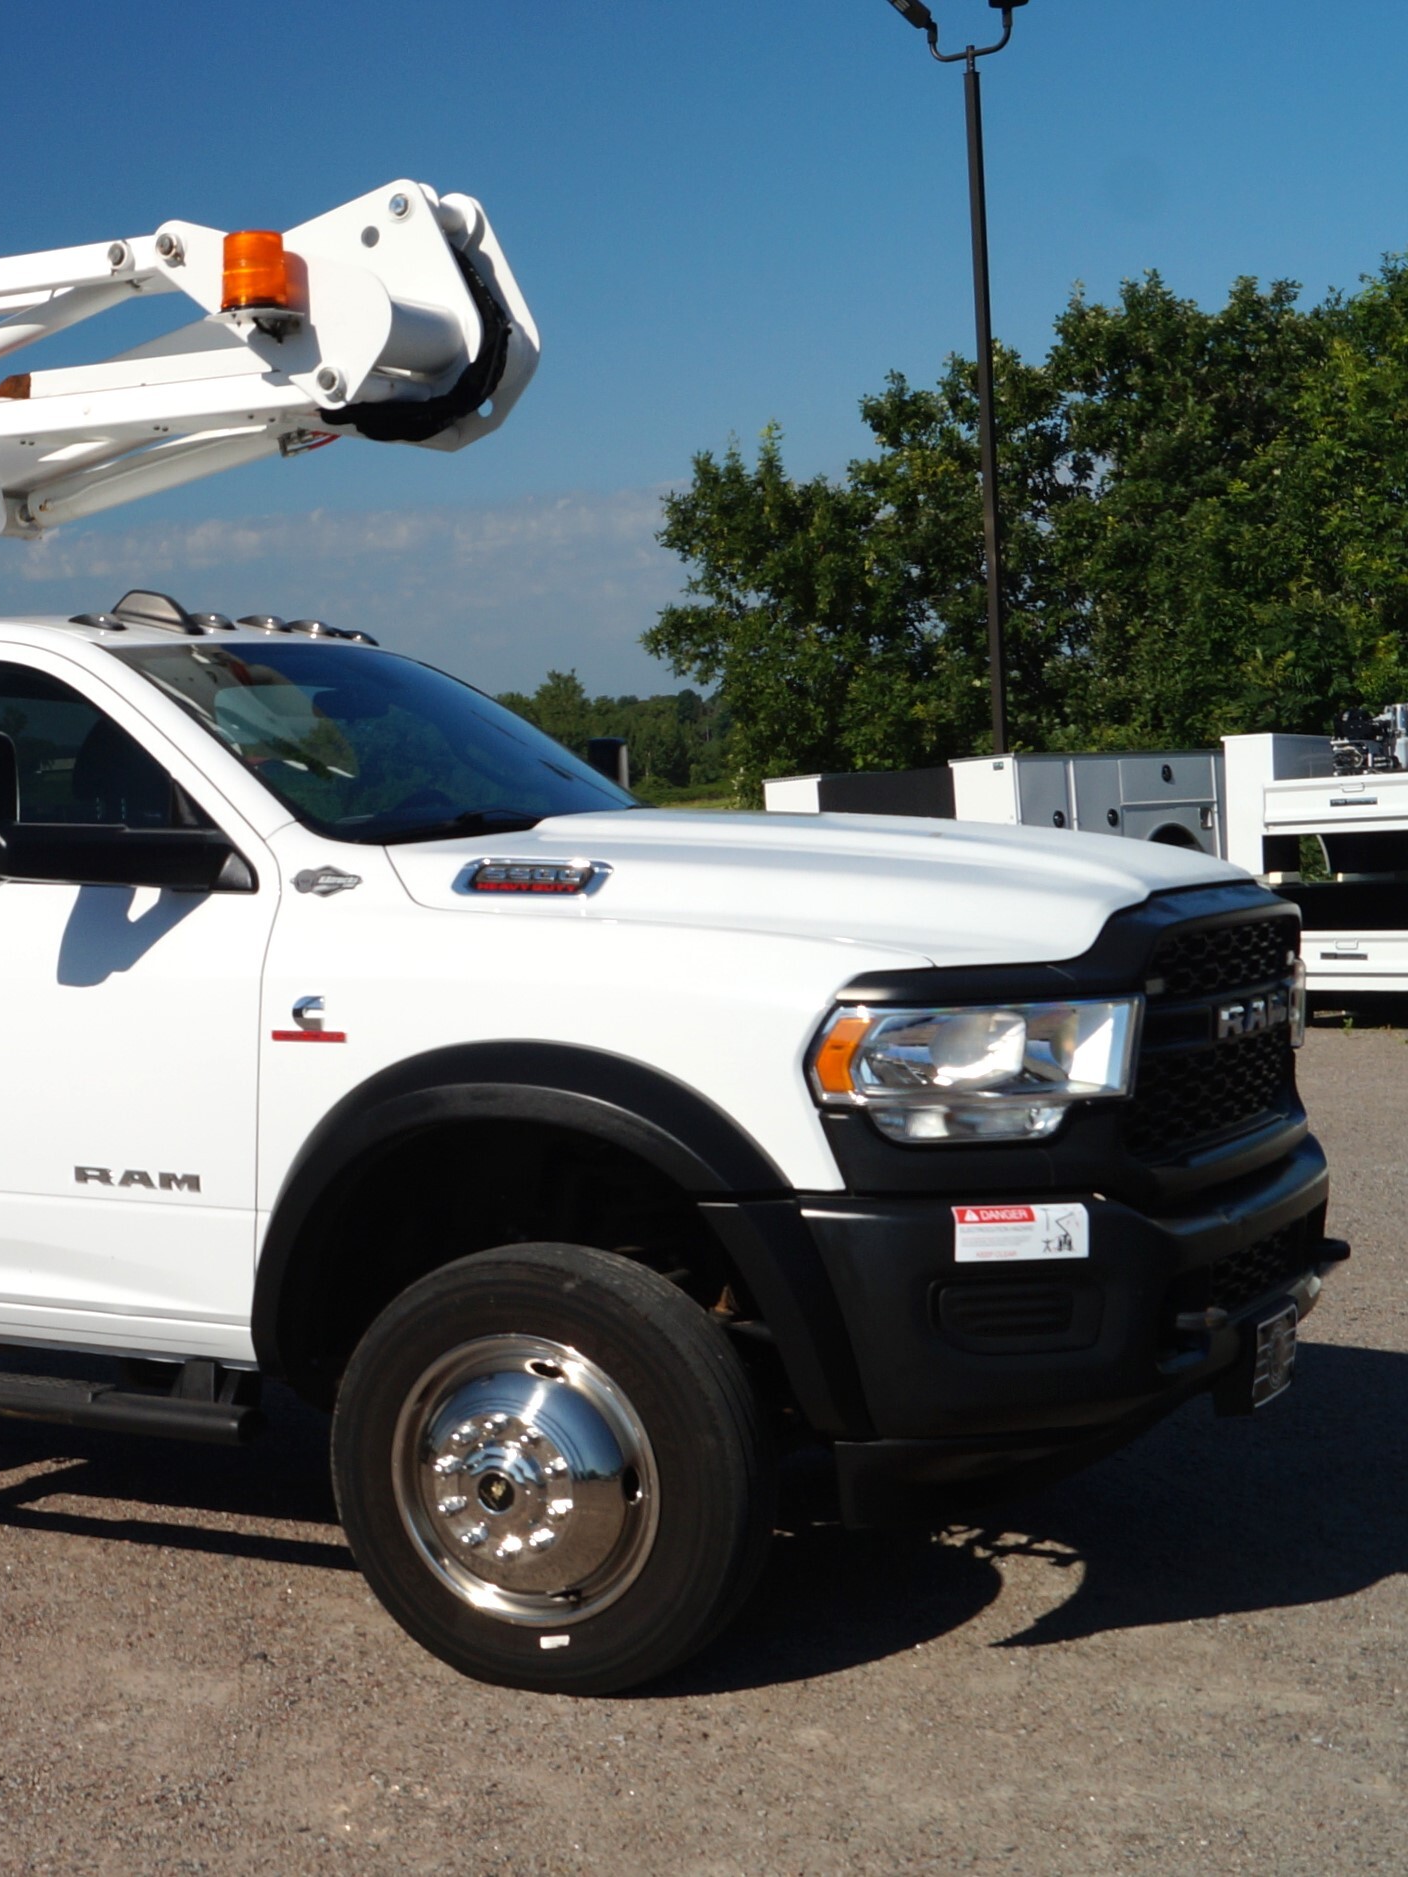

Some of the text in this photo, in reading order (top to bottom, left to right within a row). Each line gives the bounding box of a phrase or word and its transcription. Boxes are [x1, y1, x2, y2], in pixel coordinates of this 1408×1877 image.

[476, 881, 577, 892] HEAVY DUTY
[74, 1165, 201, 1193] RAM
[979, 1209, 1028, 1221] DANGER
